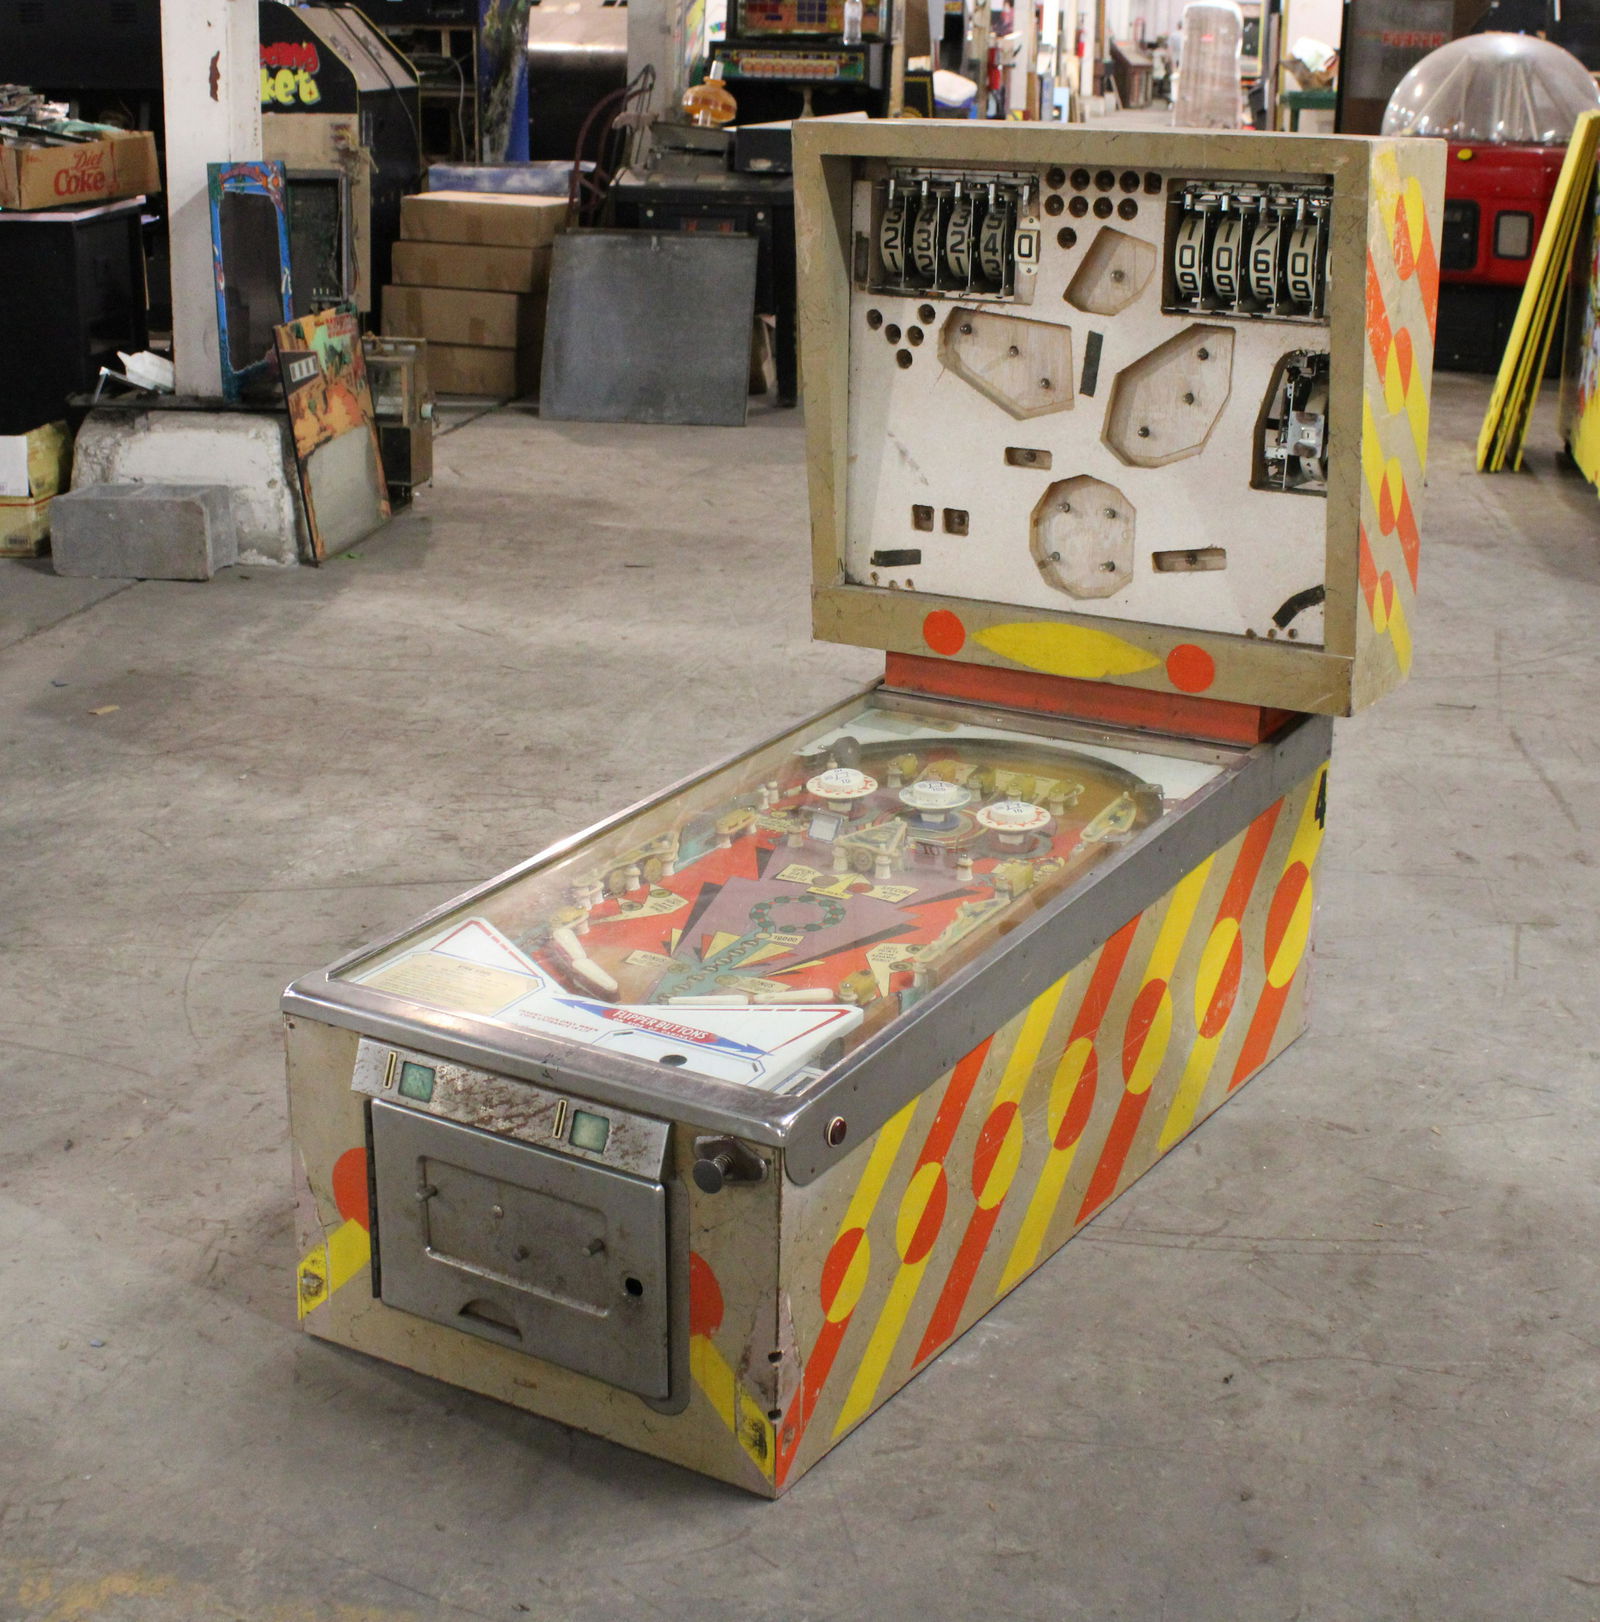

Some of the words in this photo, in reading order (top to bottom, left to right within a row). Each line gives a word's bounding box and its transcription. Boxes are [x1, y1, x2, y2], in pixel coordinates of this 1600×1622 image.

[73, 151, 104, 170] Diet
[54, 169, 106, 196] Coke
[884, 227, 899, 249] 2
[917, 229, 931, 251] 3
[950, 231, 965, 253] 2
[983, 233, 998, 256] 4
[1018, 234, 1033, 258] 0
[1179, 245, 1195, 269] 0
[1216, 247, 1232, 271] 0
[1254, 249, 1270, 273] 6
[1292, 252, 1308, 277] 0
[612, 1010, 657, 1027] FLIPPER
[655, 1021, 708, 1039] BUTTONS
